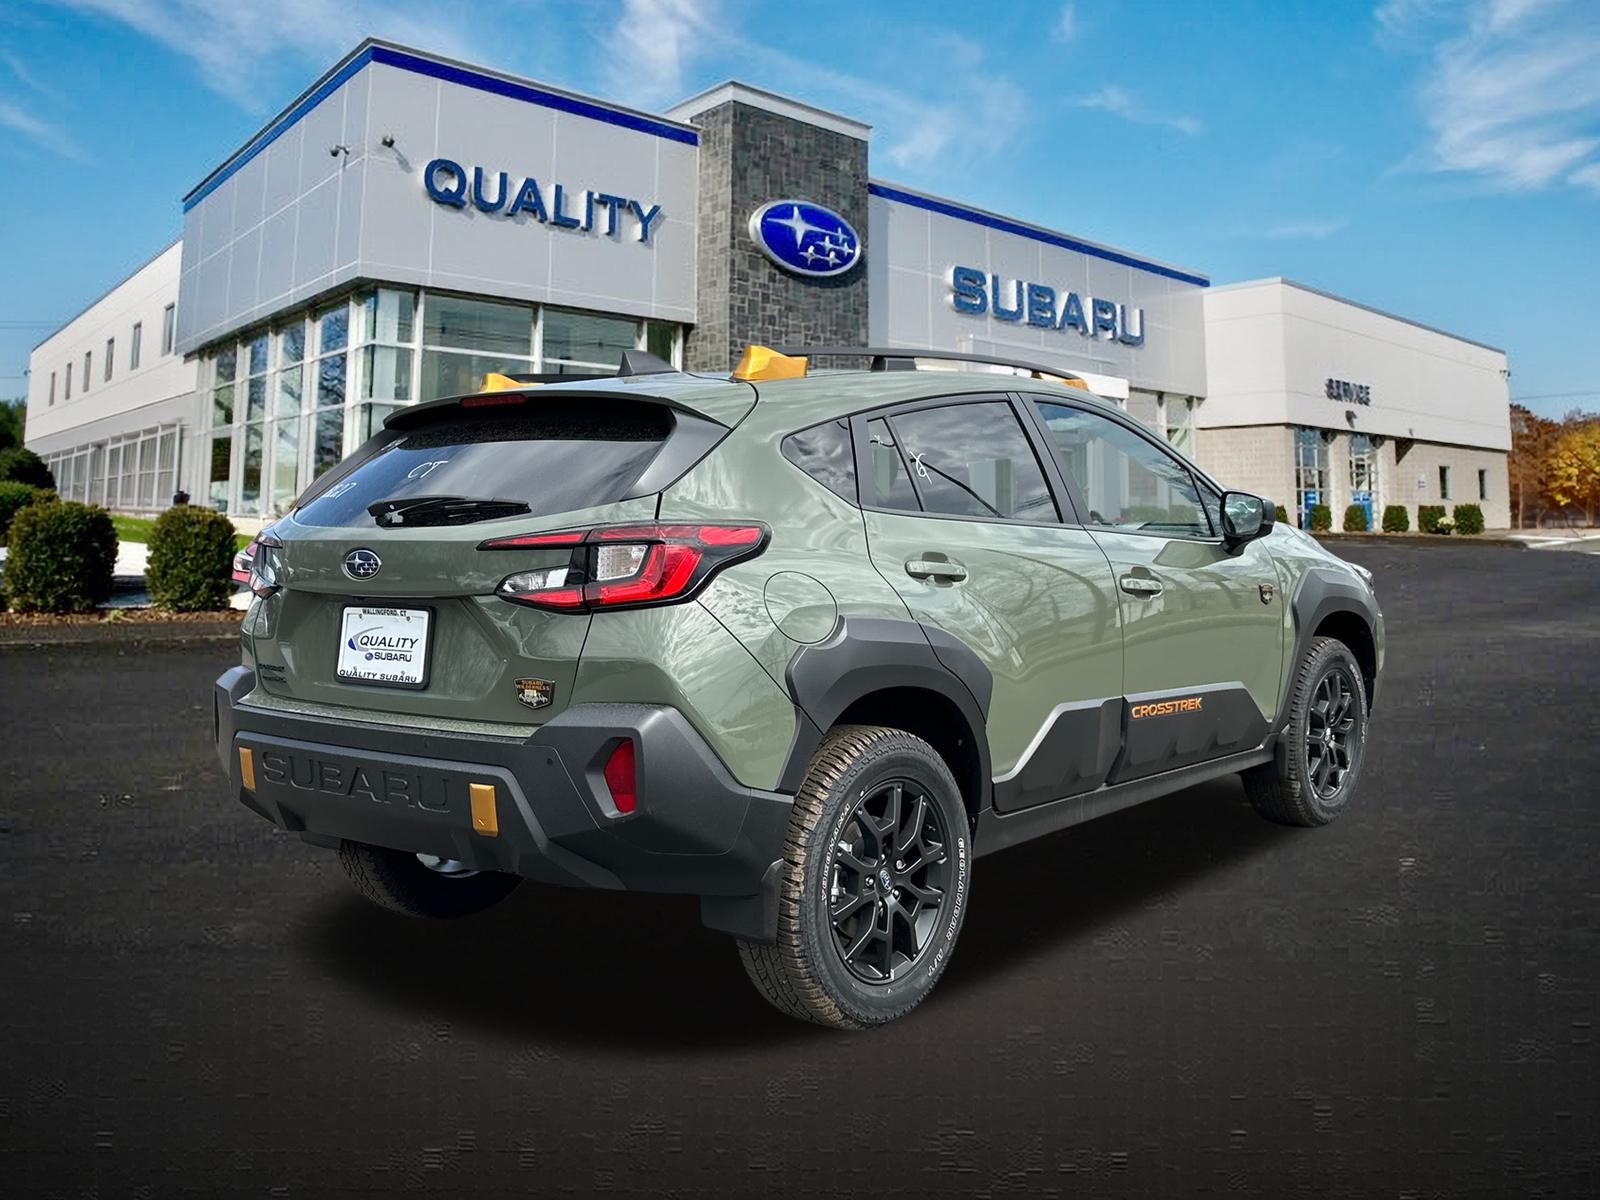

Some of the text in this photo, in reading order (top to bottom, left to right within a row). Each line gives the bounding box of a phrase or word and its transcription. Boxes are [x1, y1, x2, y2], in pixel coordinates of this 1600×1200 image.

[424, 158, 662, 243] QUALITY
[952, 265, 1145, 347] SUBARU
[360, 635, 419, 649] QUALITY
[374, 652, 412, 663] SUBARU
[339, 669, 417, 683] QUALITY SUBARU
[1131, 697, 1203, 719] CROSSTREK
[262, 751, 450, 813] SUBARU
